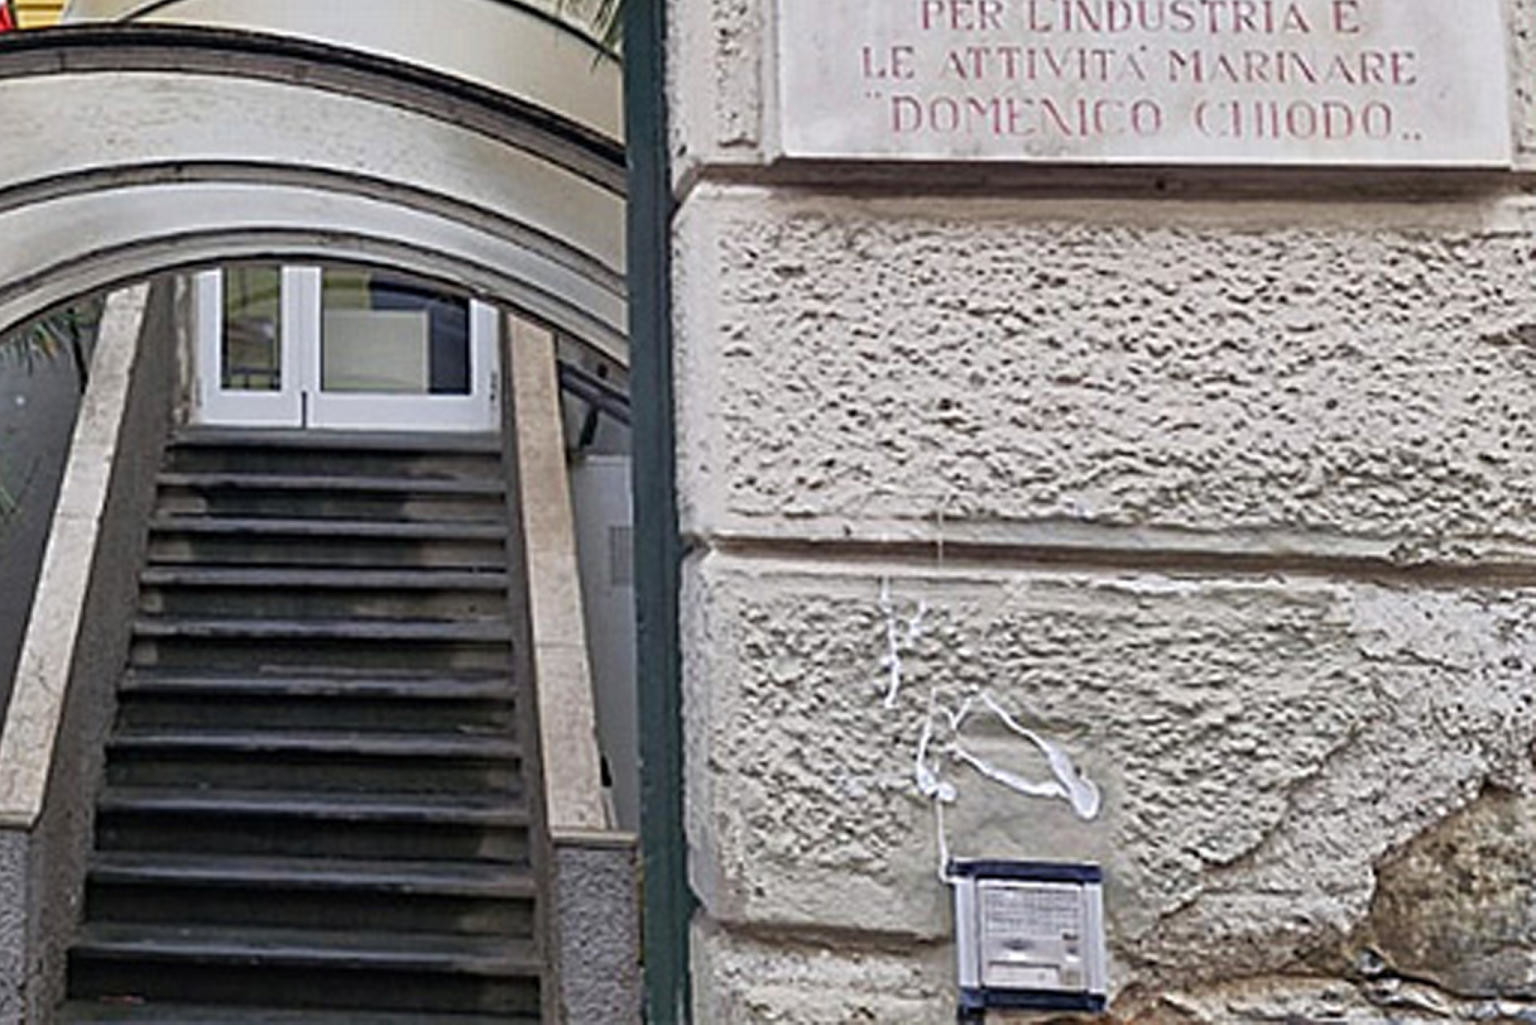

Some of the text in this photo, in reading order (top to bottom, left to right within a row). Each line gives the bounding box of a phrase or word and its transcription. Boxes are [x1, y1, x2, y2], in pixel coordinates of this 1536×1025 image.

[1332, 0, 1360, 34] E
[862, 45, 915, 78] LE
[1168, 49, 1417, 84] MARINARE
